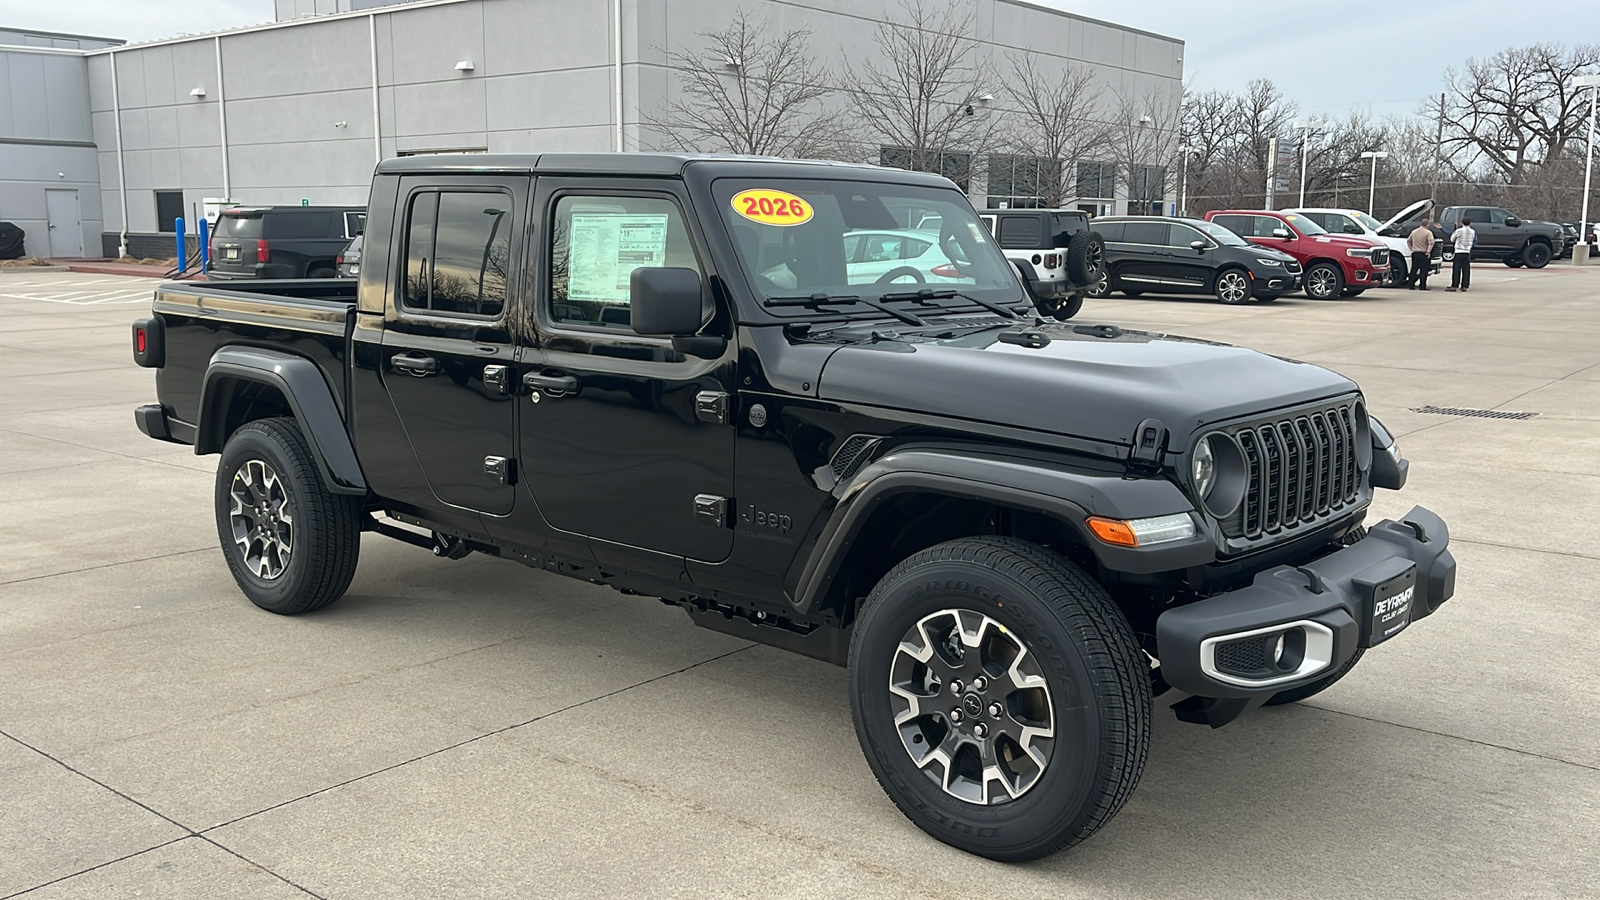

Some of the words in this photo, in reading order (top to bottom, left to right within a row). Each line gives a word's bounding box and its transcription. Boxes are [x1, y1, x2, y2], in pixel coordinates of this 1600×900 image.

[742, 196, 805, 218] 2026
[741, 503, 793, 534] Jeep
[1374, 584, 1415, 617] DEYARMAN
